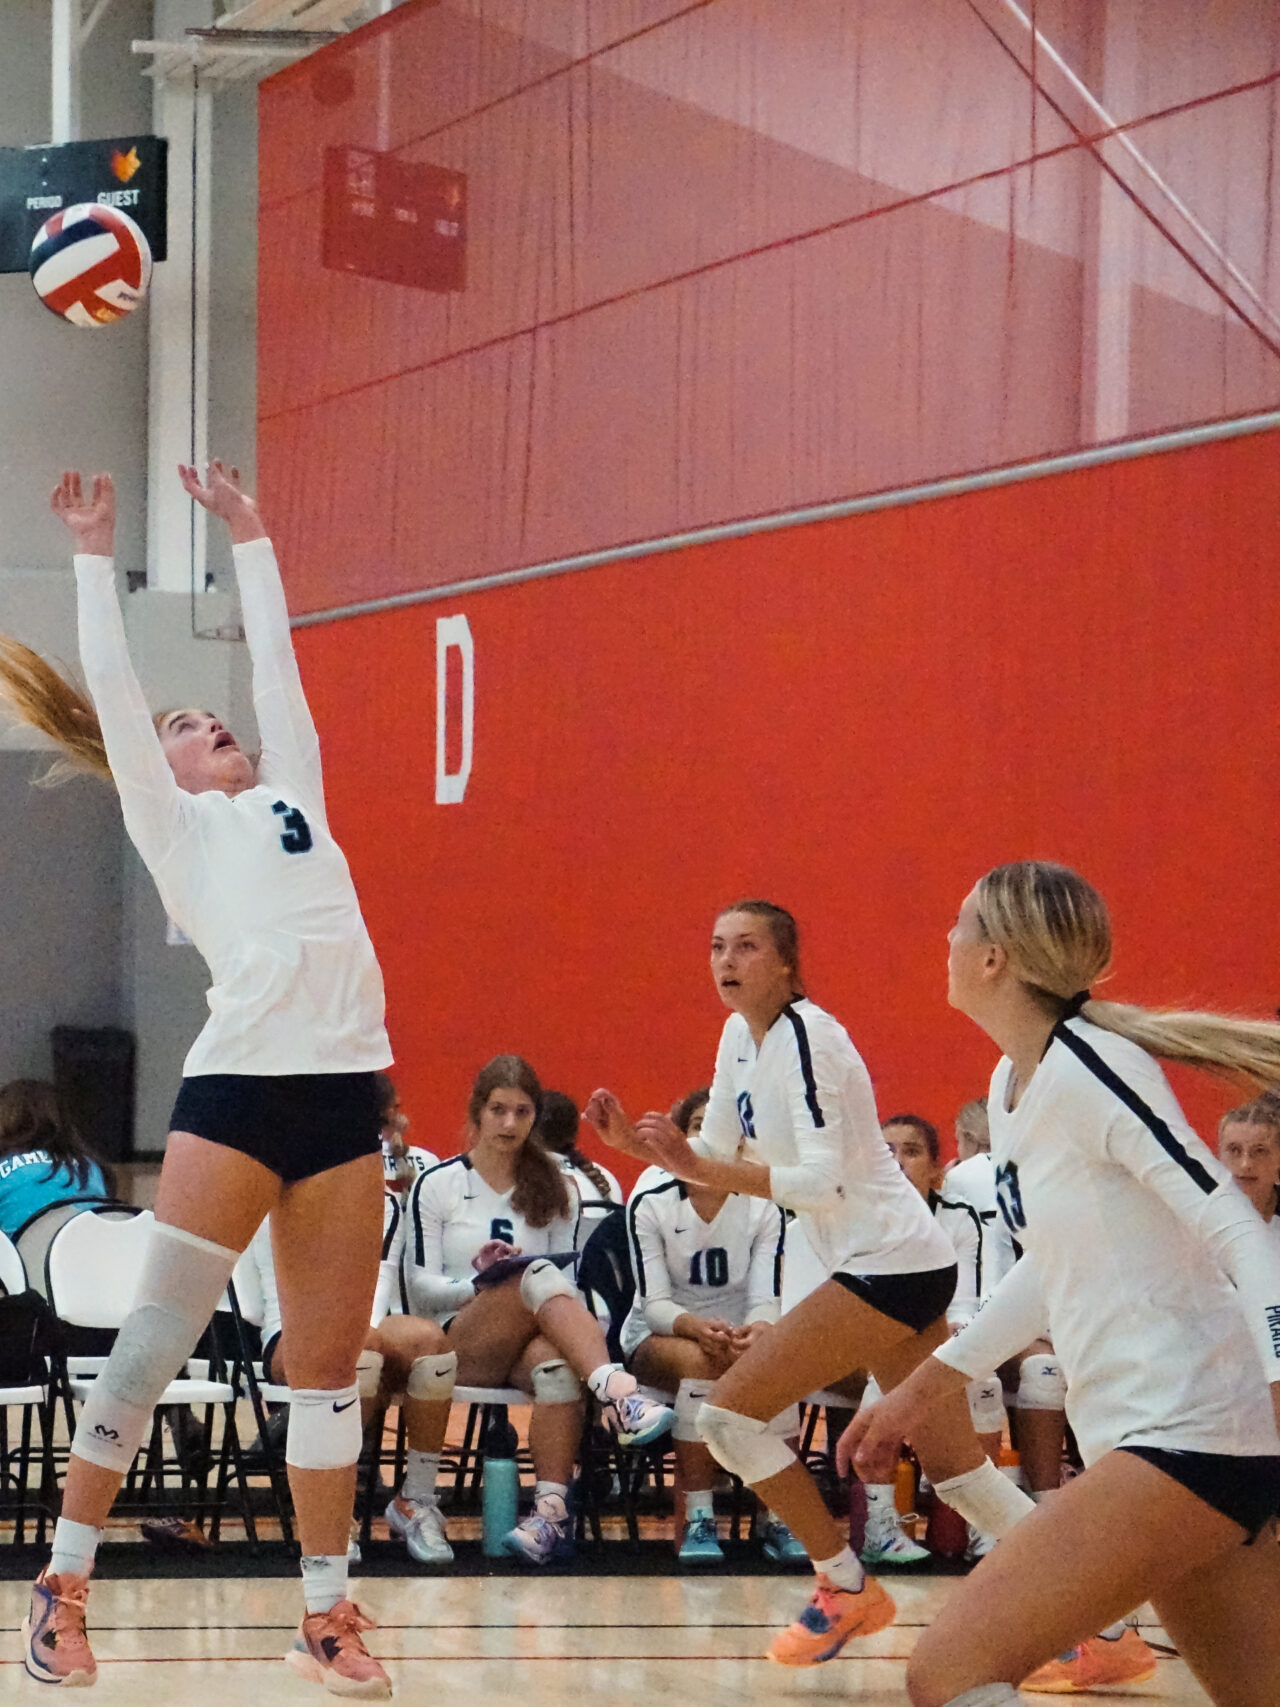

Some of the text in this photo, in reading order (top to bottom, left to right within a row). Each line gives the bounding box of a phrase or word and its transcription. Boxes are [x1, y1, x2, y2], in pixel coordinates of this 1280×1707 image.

[26, 189, 140, 210] PERIOD GUEST
[436, 613, 474, 805] D
[270, 799, 313, 854] 3
[688, 1247, 729, 1287] 10
